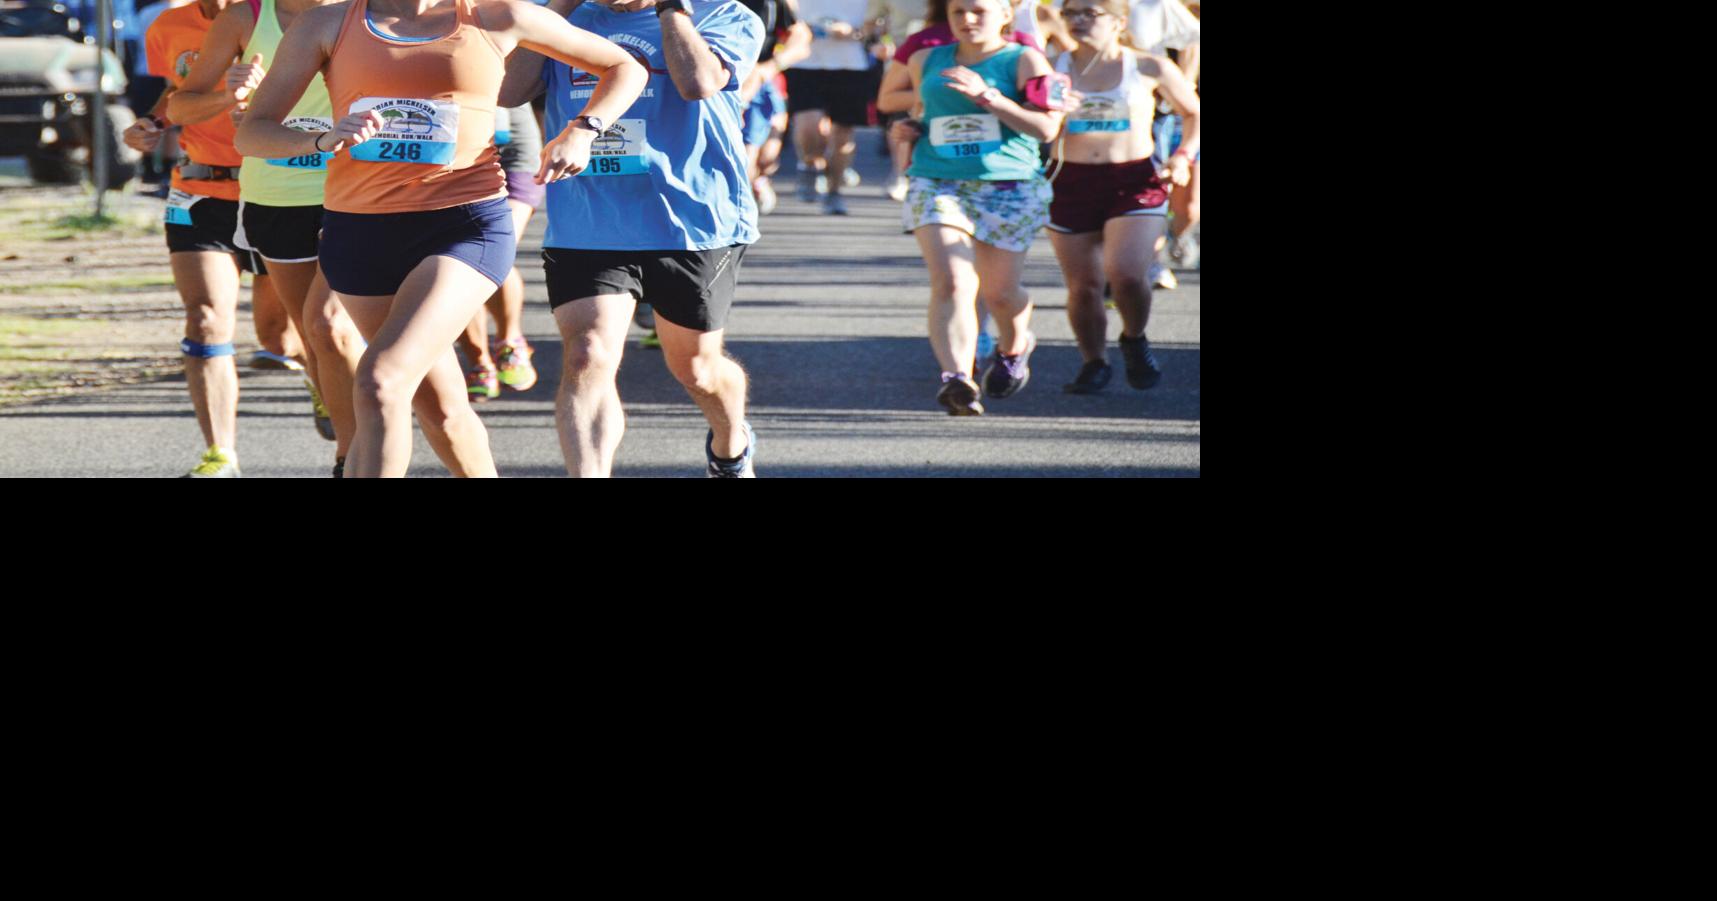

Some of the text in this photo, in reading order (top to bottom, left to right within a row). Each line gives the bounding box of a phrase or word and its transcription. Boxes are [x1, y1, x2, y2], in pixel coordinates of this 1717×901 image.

[397, 99, 437, 116] MICKELSEN
[379, 141, 422, 160] 246
[953, 143, 980, 157] 130
[288, 153, 321, 167] 208
[590, 157, 621, 174] 195
